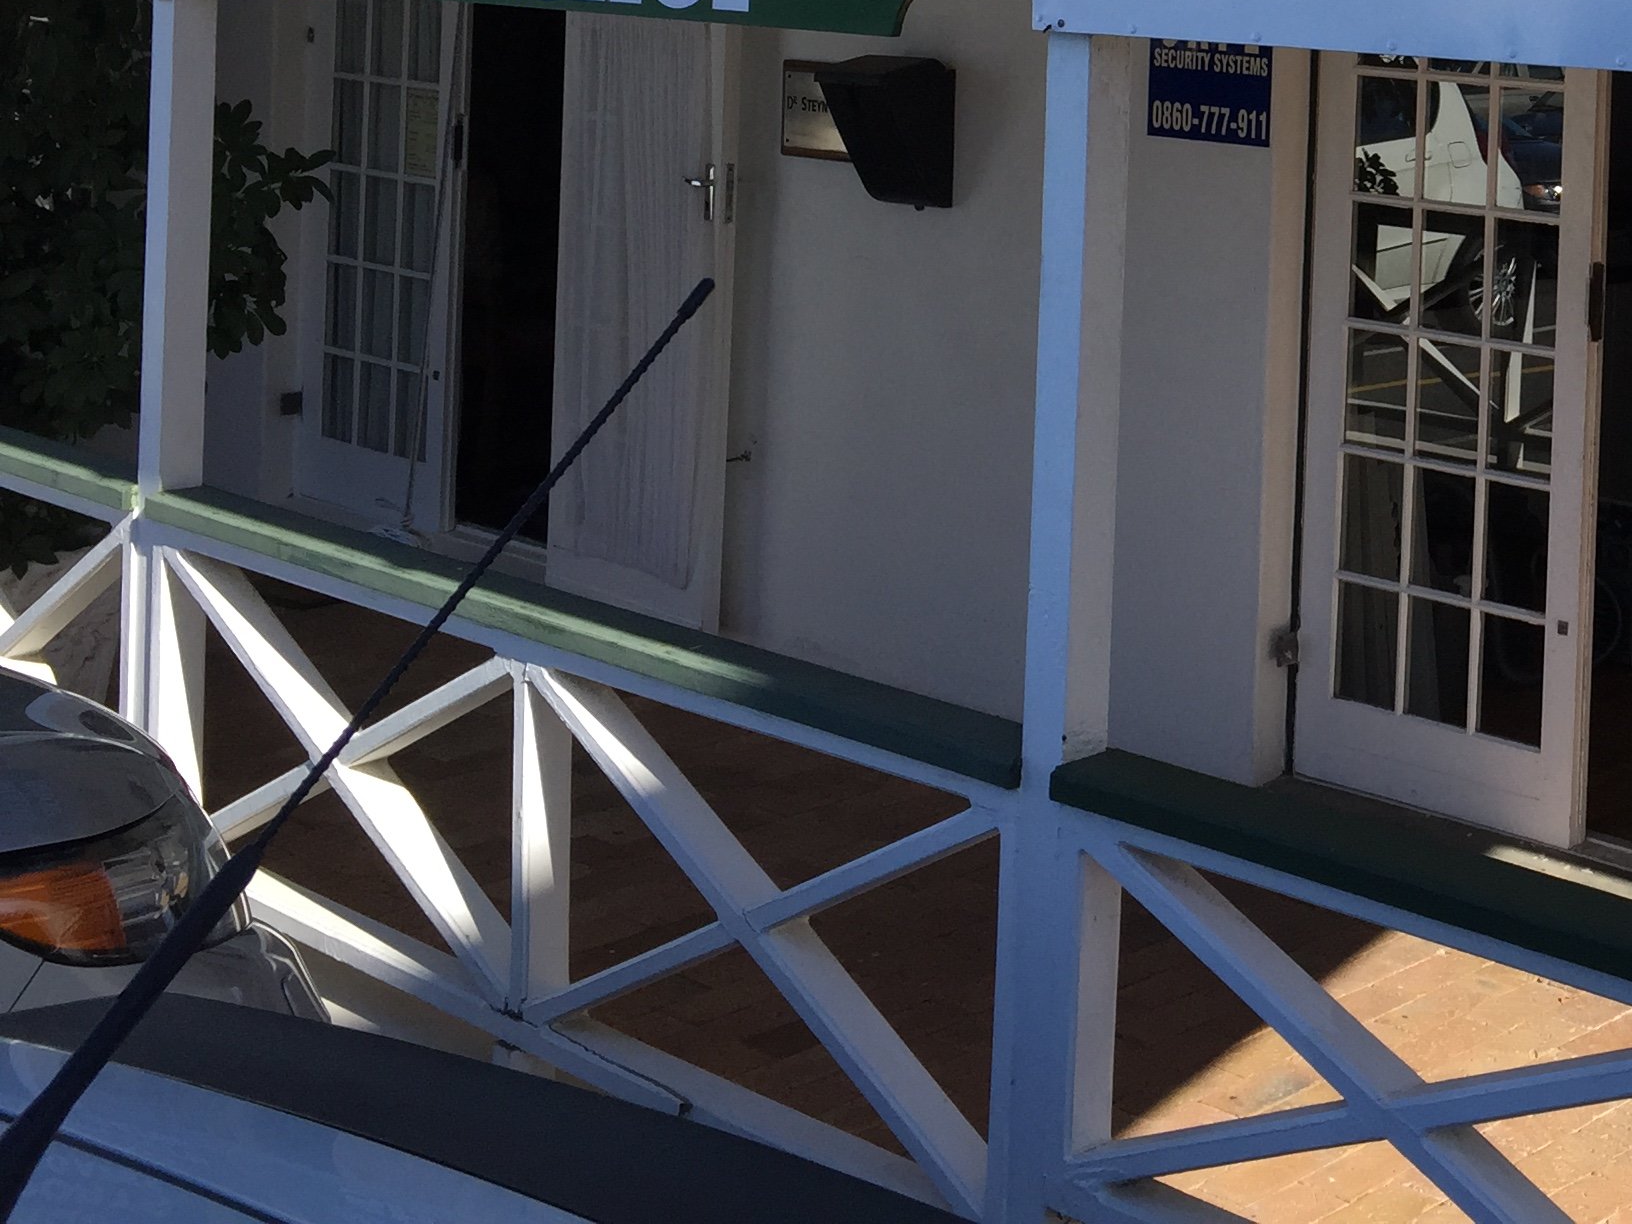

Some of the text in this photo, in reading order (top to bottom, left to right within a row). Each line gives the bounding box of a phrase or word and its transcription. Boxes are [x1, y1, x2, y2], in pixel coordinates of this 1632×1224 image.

[1153, 47, 1269, 77] SECURITY SYSTEMS
[1152, 99, 1268, 140] 0860-777-911
